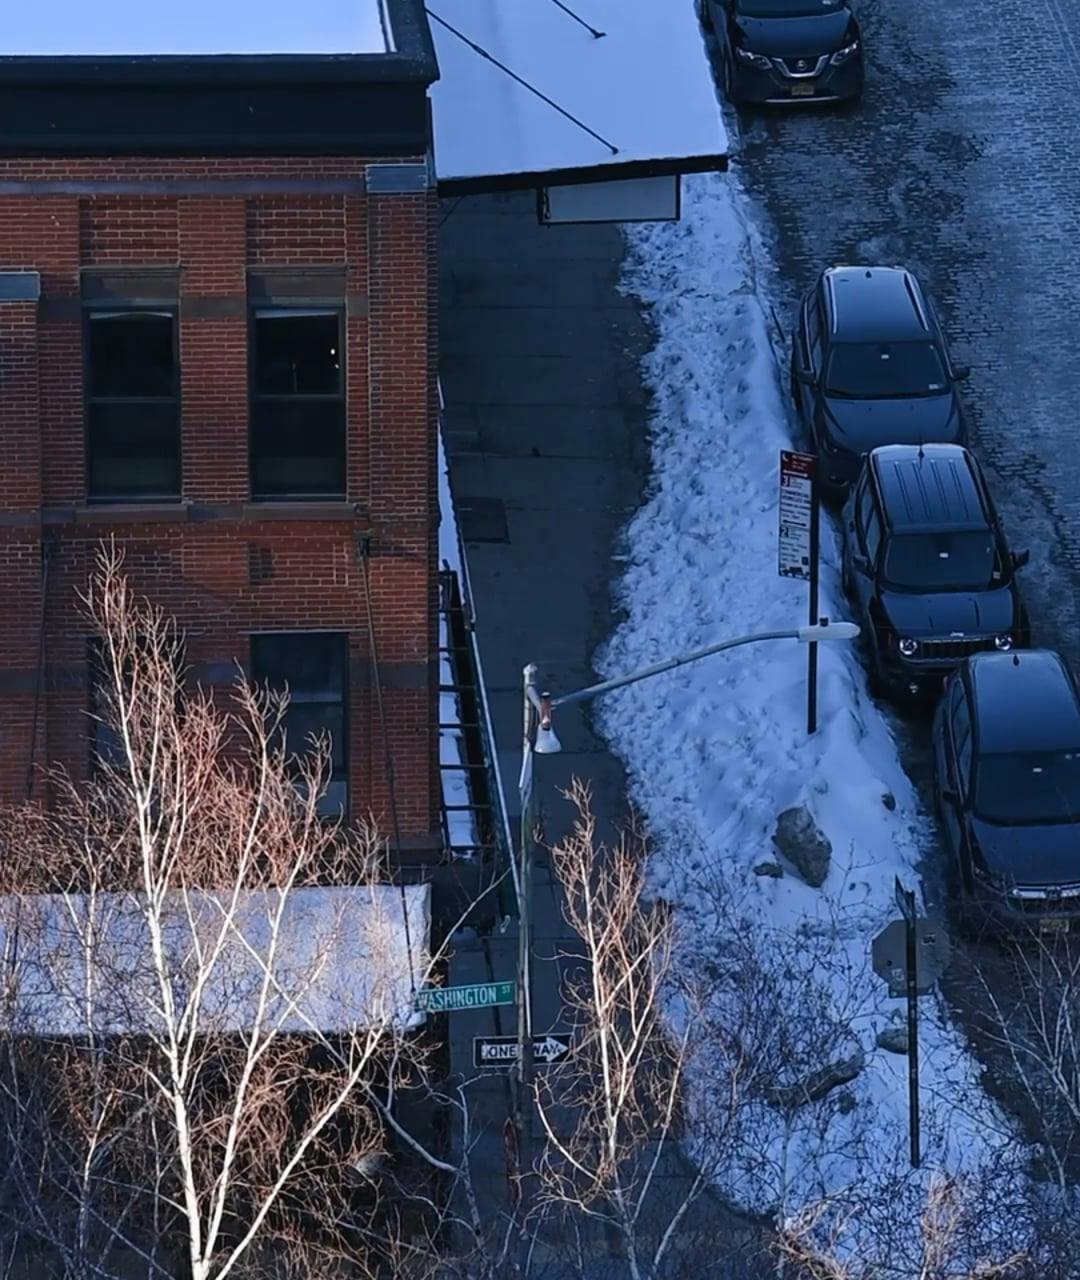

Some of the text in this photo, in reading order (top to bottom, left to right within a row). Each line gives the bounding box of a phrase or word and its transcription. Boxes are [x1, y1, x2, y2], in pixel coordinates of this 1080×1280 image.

[418, 985, 511, 1010] WASHINGTON ST
[489, 1045, 516, 1057] ONE
